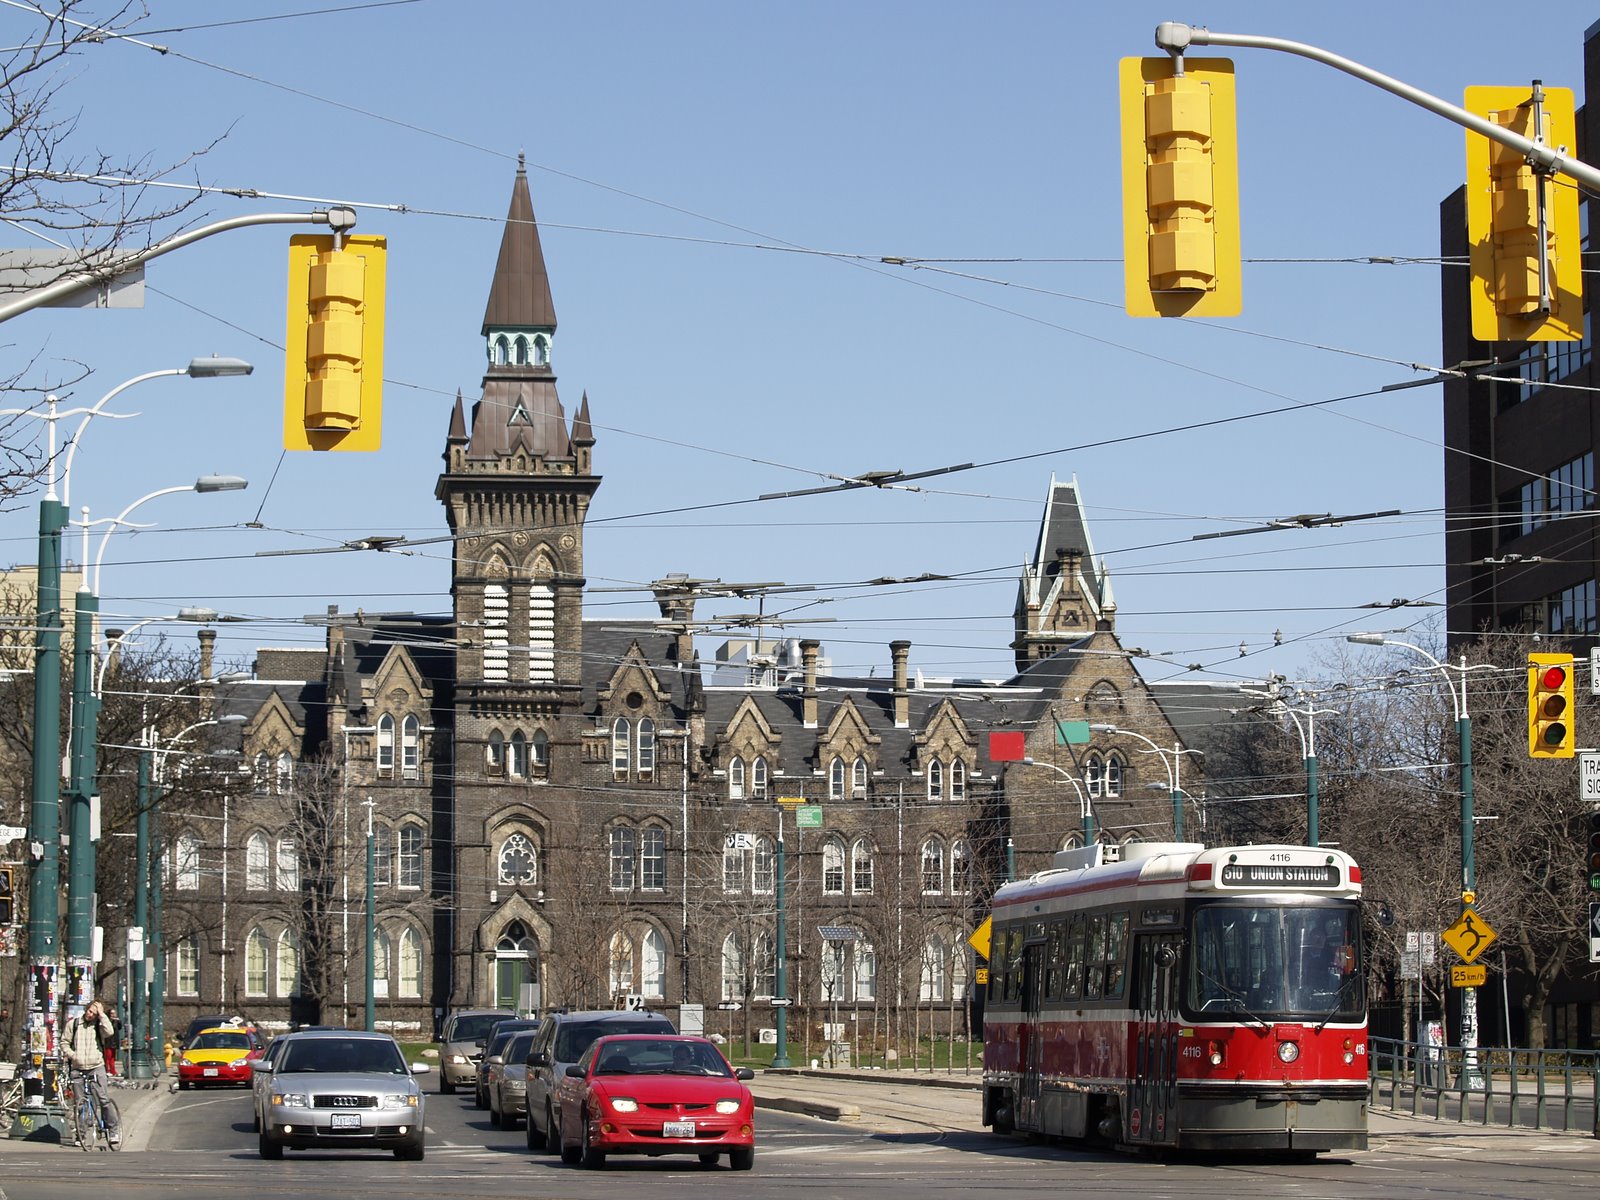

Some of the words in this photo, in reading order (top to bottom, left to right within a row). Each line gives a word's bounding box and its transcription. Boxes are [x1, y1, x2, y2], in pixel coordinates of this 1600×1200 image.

[1269, 854, 1291, 862] 4116
[1224, 866, 1243, 880] 510
[1250, 866, 1284, 880] UNION
[1286, 867, 1328, 880] STATION
[1454, 971, 1466, 981] 25
[1182, 1046, 1202, 1058] 4116
